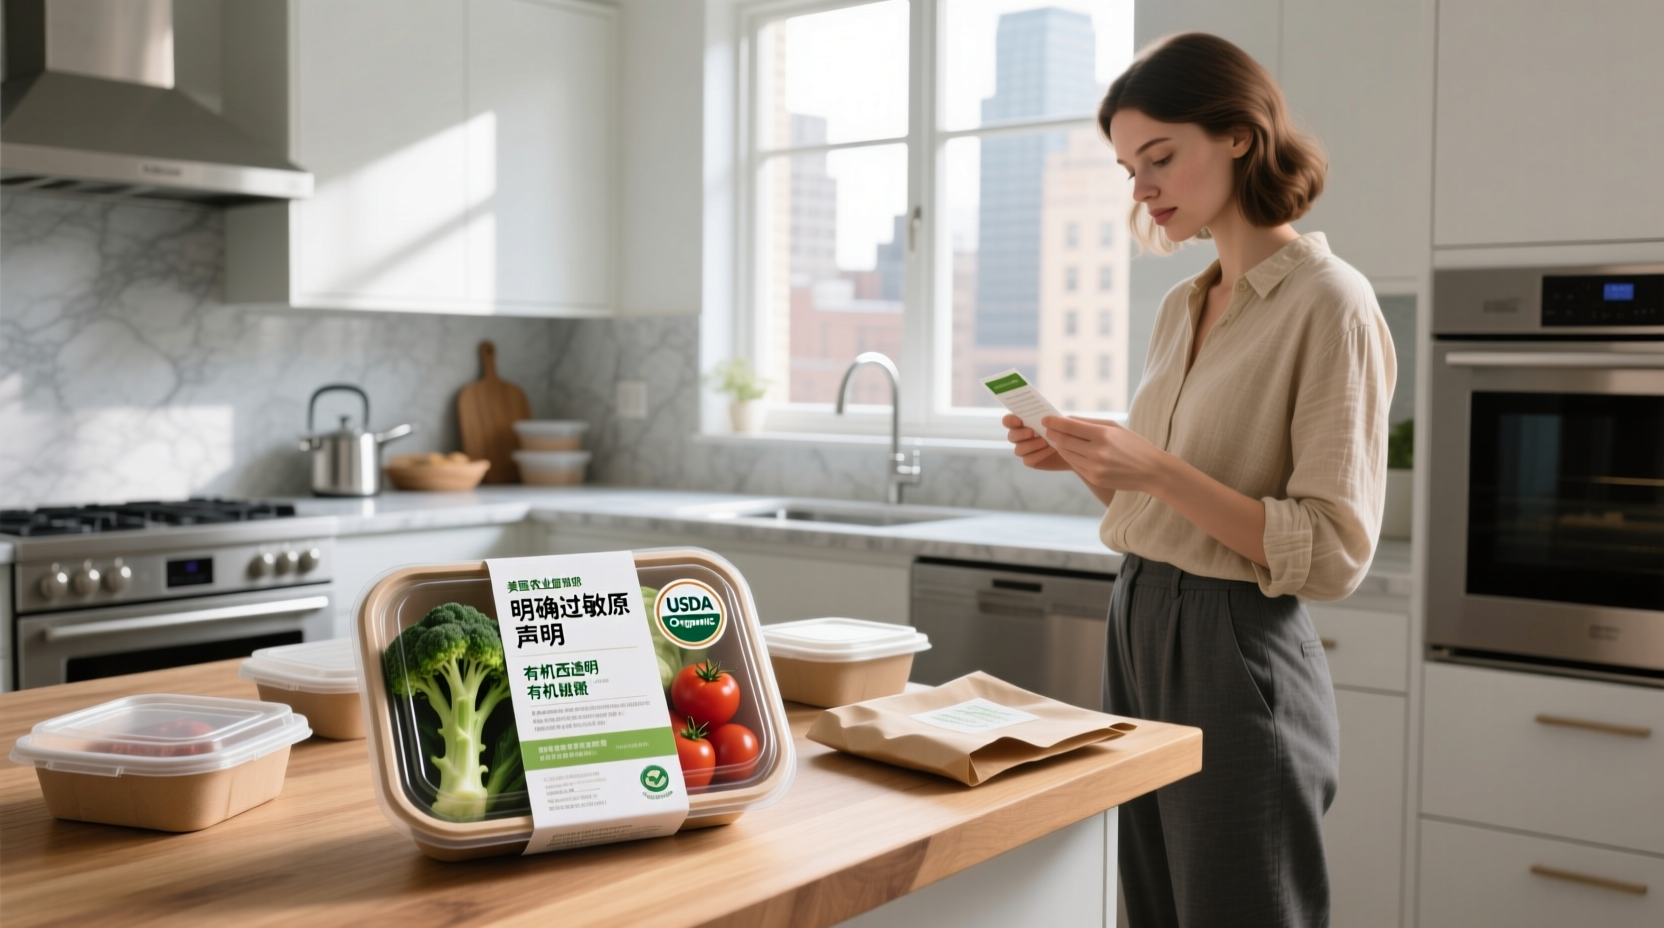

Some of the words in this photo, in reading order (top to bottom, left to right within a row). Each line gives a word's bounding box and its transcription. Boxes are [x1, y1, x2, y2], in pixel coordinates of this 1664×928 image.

[510, 592, 631, 622] 明确过敏原
[666, 595, 714, 613] USDA
[515, 623, 565, 649] 声明
